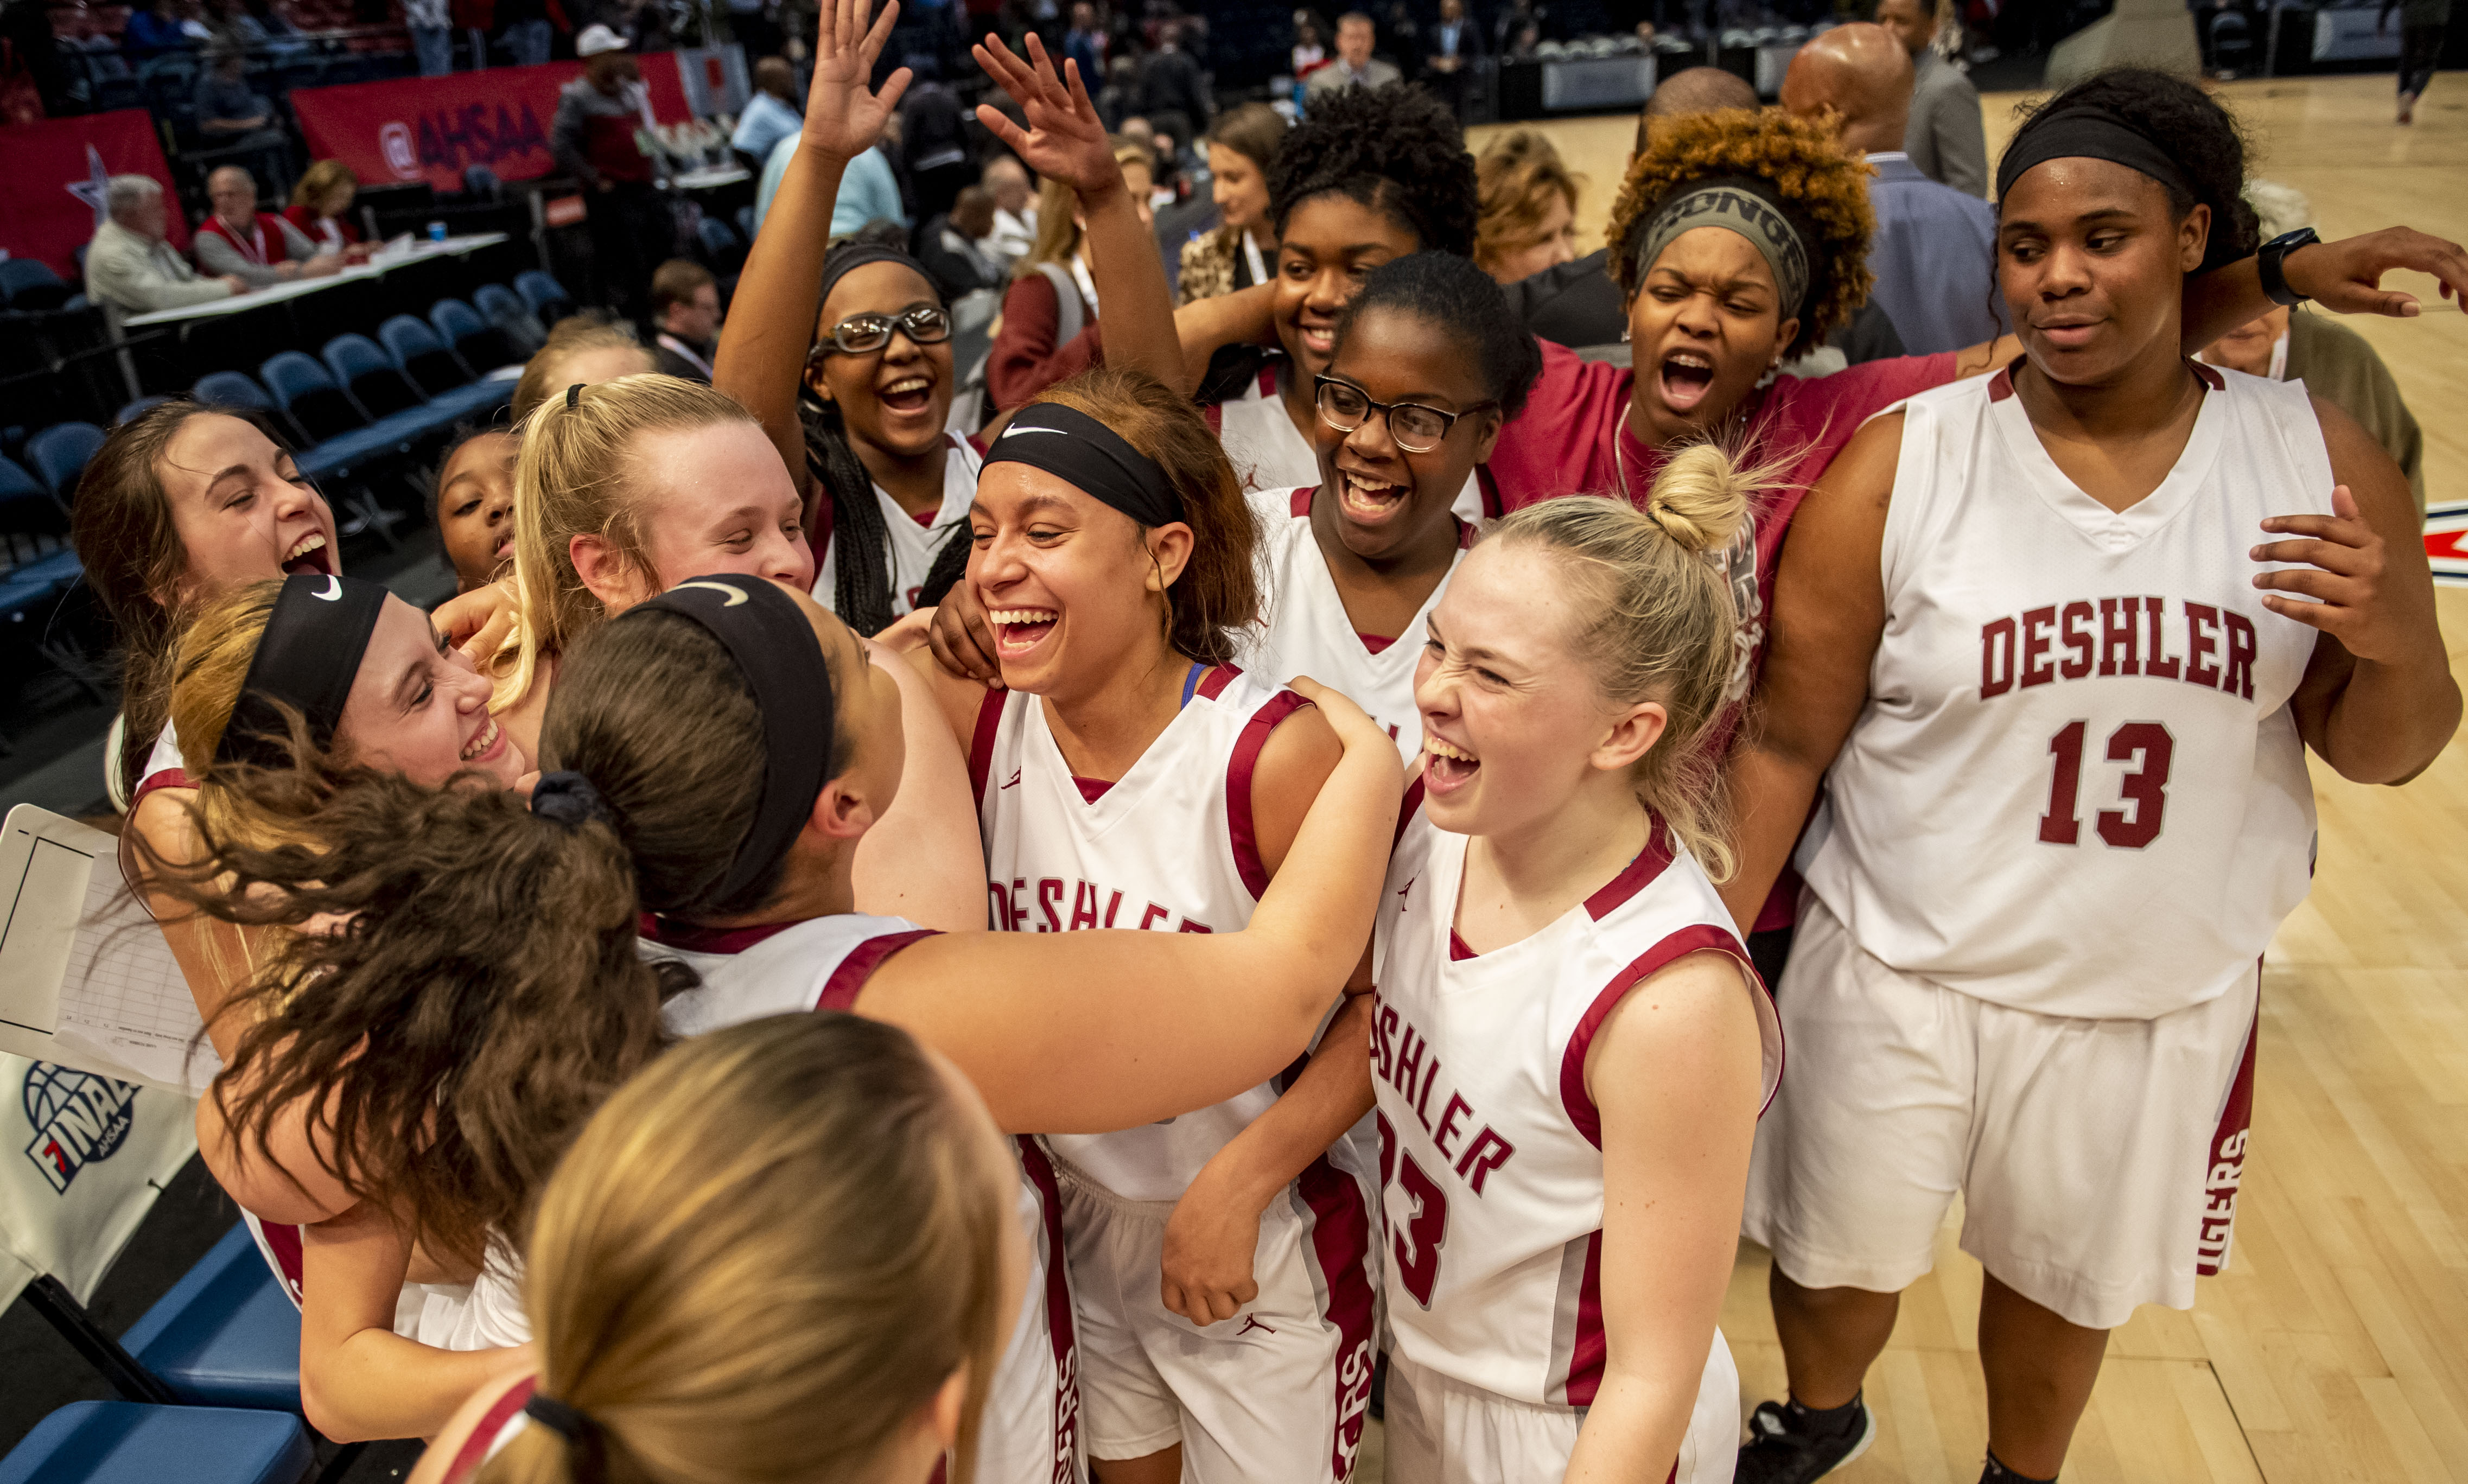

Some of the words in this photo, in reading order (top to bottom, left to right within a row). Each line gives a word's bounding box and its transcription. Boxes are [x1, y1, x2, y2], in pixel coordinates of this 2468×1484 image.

[379, 101, 549, 179] @AHSAA
[1980, 595, 2259, 704] DESHLER
[2036, 718, 2177, 851] 13
[28, 1077, 141, 1192] FINAL
[98, 1115, 130, 1157] AHSAA
[2198, 1128, 2250, 1266] IGERS
